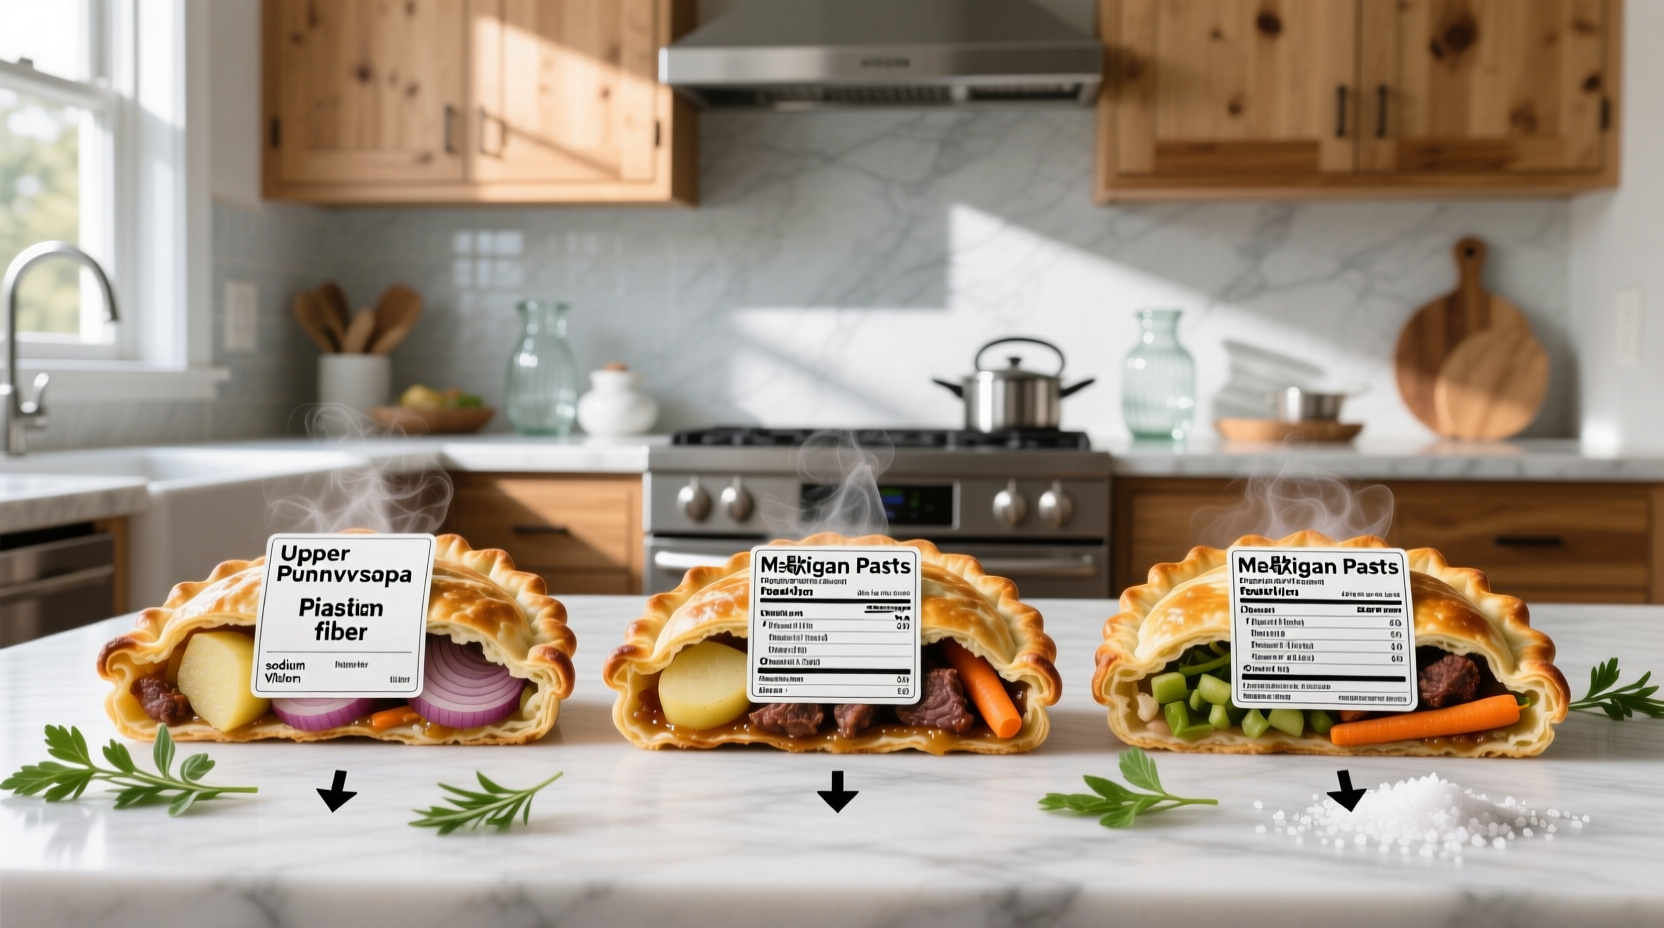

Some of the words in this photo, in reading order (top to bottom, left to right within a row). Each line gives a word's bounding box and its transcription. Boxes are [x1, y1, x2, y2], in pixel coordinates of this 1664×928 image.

[281, 545, 350, 566] Upper
[856, 557, 911, 575] Pasts
[1343, 558, 1399, 575] Pasts
[314, 620, 368, 641] fiber
[265, 658, 305, 670] sodium
